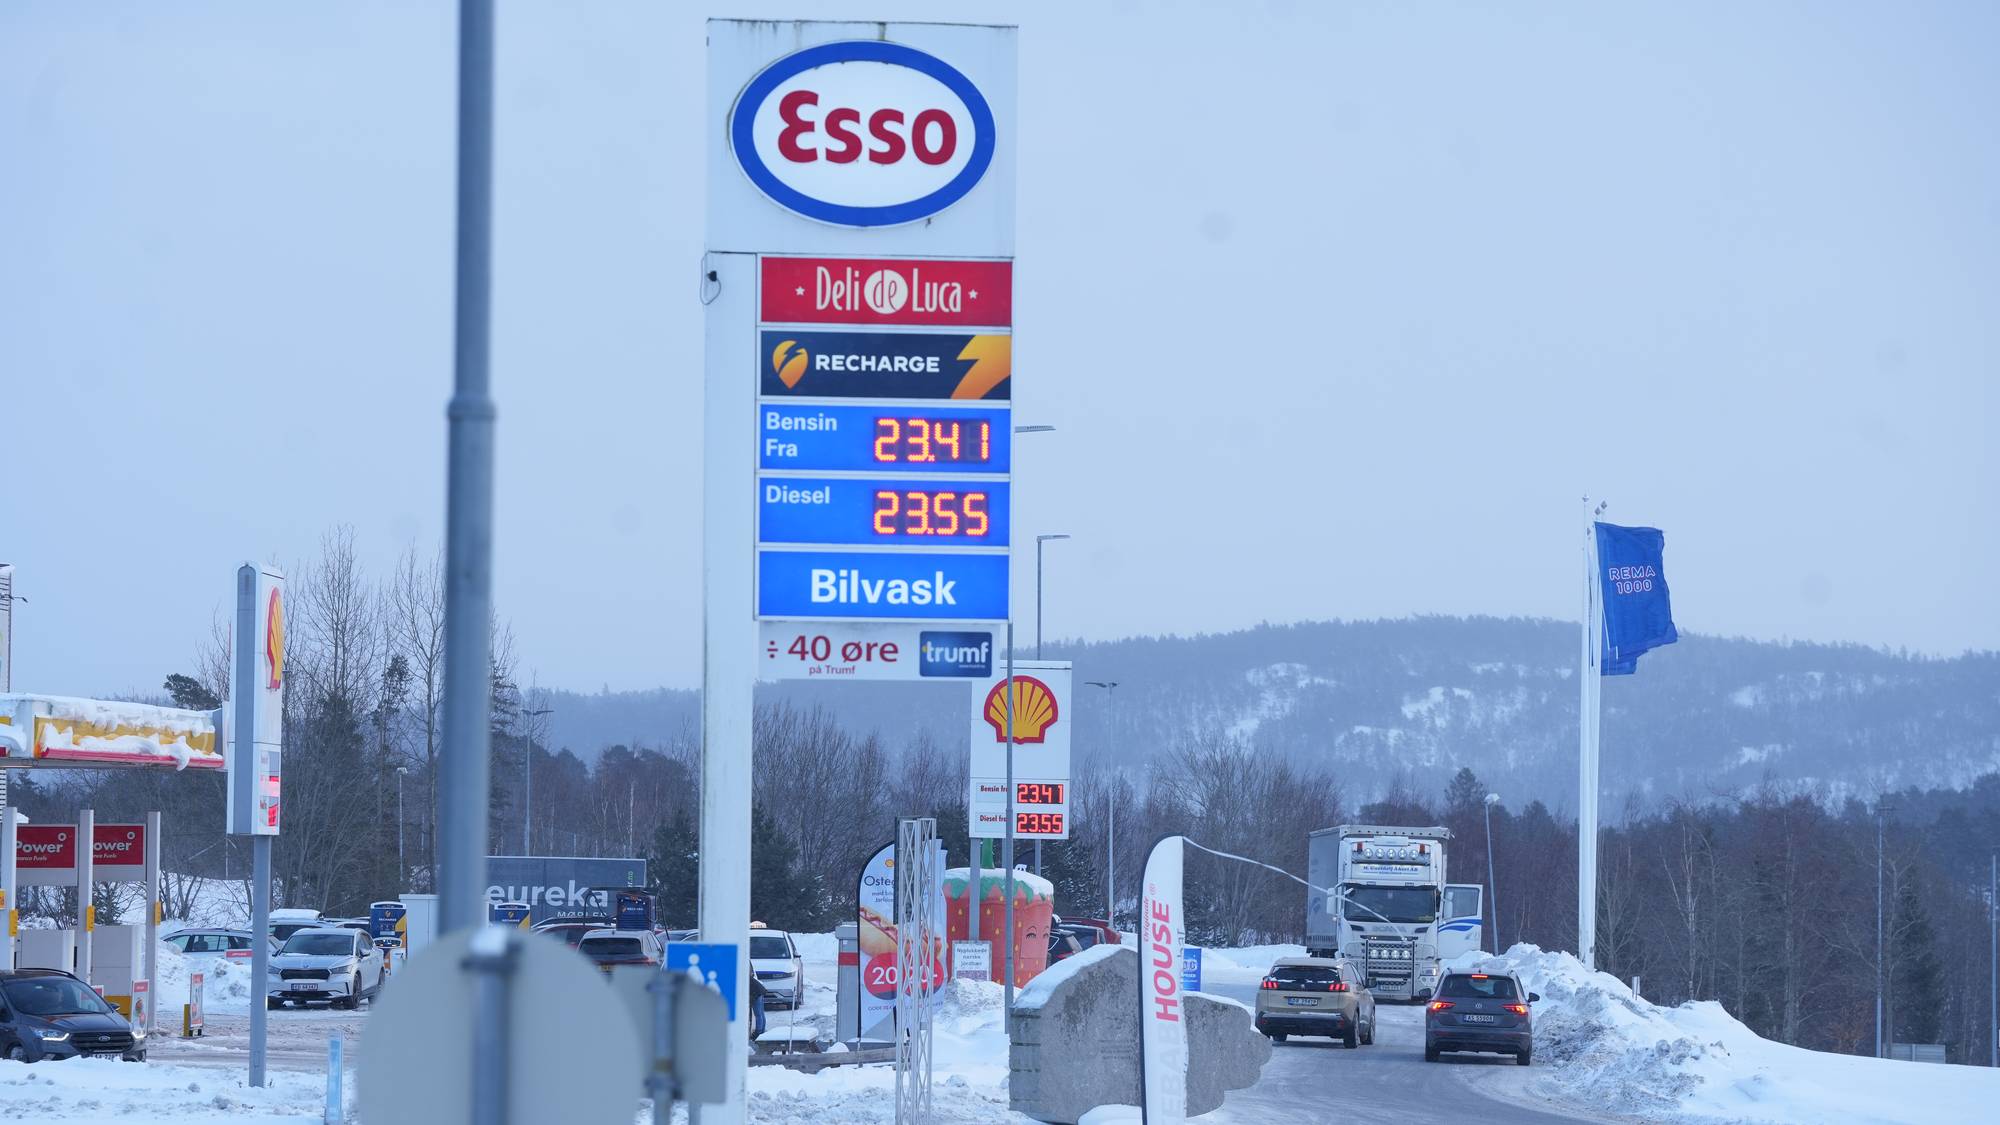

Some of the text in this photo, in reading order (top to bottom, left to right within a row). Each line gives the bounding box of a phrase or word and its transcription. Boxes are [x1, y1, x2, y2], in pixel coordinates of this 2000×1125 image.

[815, 265, 962, 313] Deli de Luca
[815, 353, 940, 373] RECHARGE
[766, 411, 838, 432] Bensin
[766, 438, 798, 458] Fra
[874, 418, 990, 462] 23.41
[766, 485, 831, 504] Diesel
[873, 491, 989, 536] 23.55
[1609, 565, 1656, 580] REMA
[811, 568, 957, 606] Bilvask
[1616, 579, 1652, 594] 1000
[788, 634, 832, 662] 40
[841, 639, 899, 664] øre
[926, 640, 989, 663] trumf
[809, 664, 856, 675] på Trumf
[981, 784, 1000, 792] Bensin
[1018, 784, 1063, 803] 23.41
[980, 814, 998, 822] Diesel
[1017, 814, 1063, 833] 23.55
[93, 840, 132, 851] ower
[485, 880, 608, 908] eureka
[1152, 899, 1179, 1022] HOUSE
[1157, 1023, 1183, 1125] EBAB
